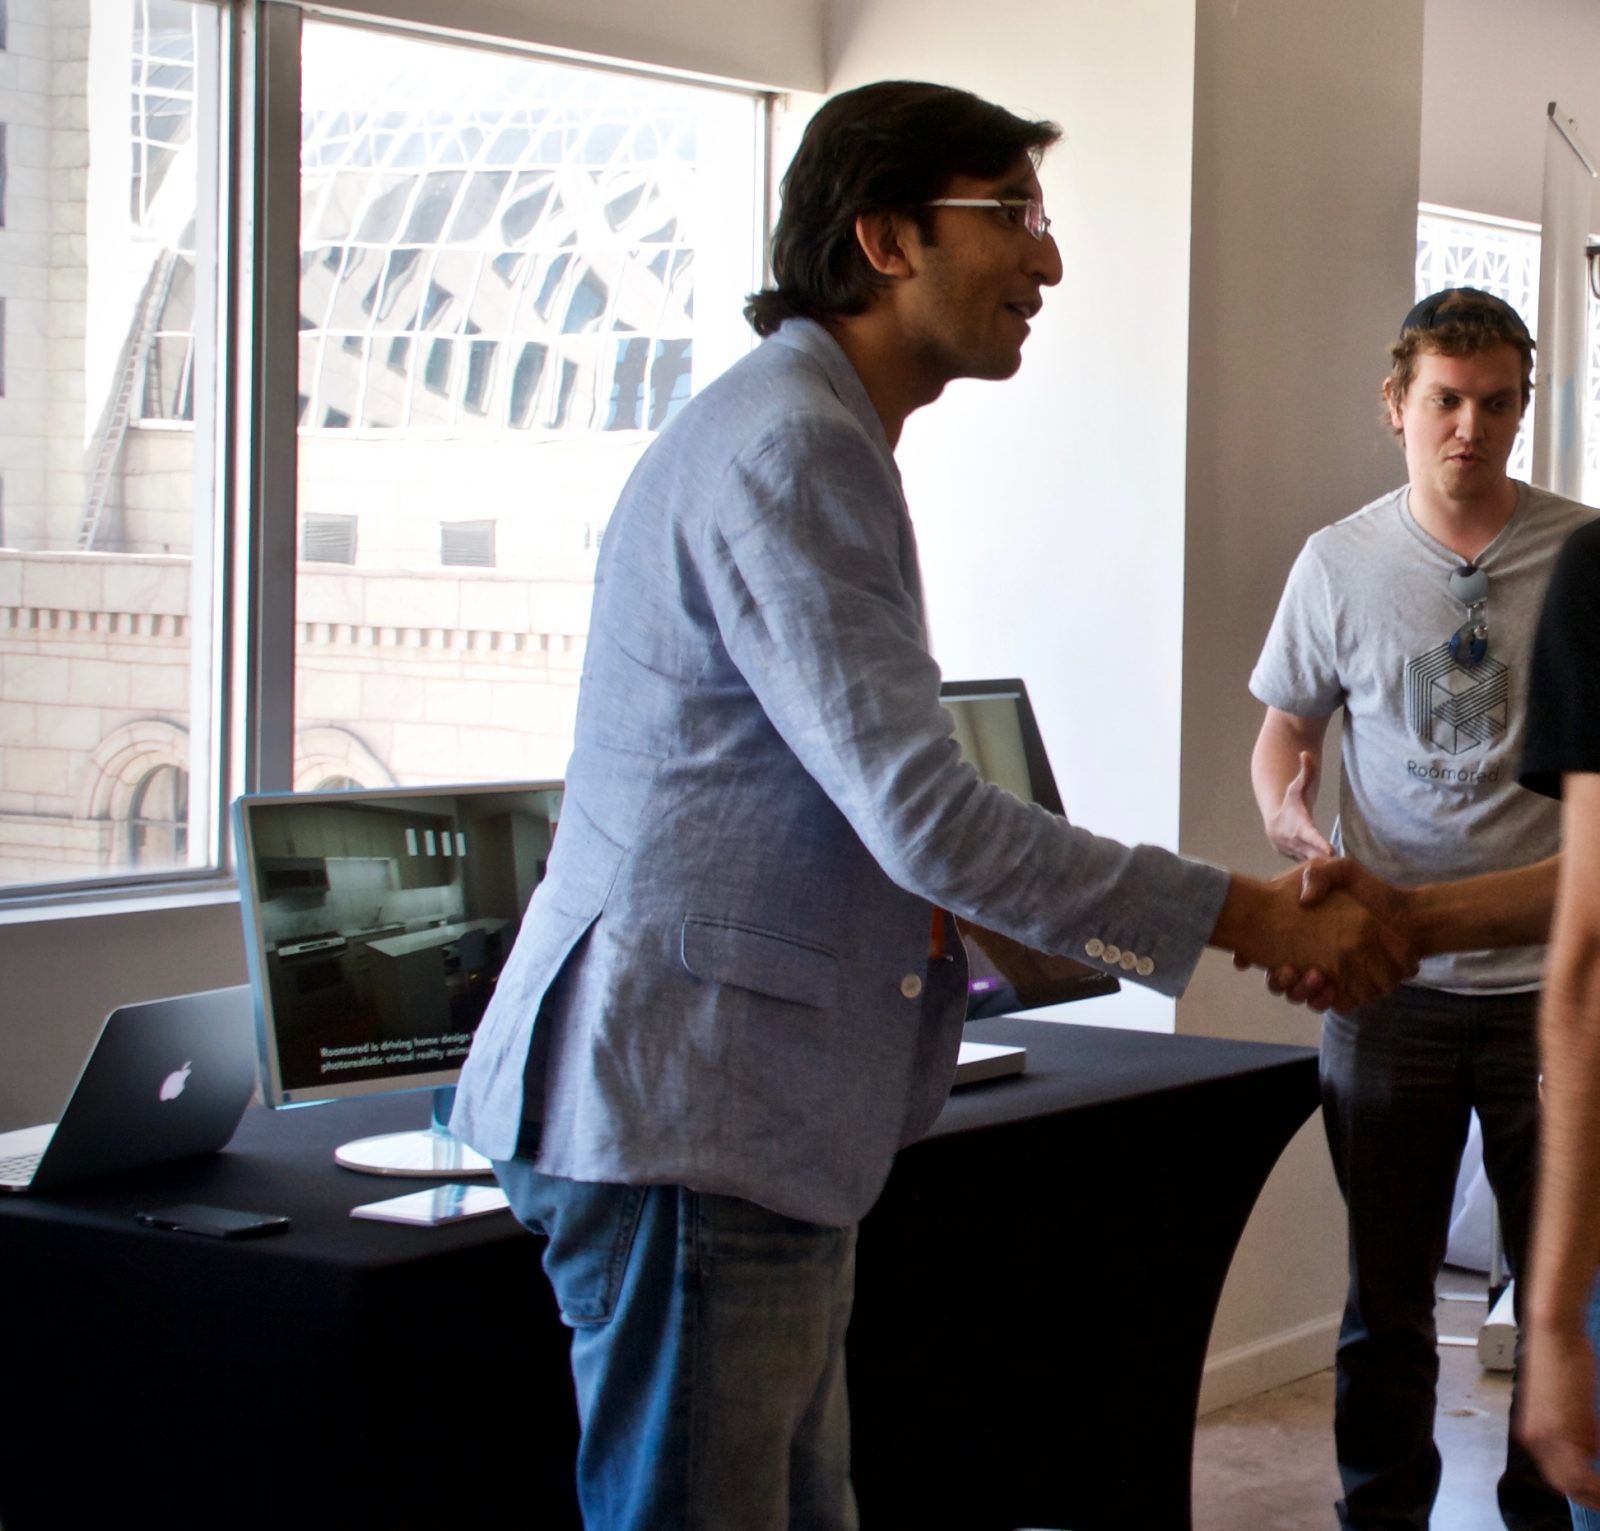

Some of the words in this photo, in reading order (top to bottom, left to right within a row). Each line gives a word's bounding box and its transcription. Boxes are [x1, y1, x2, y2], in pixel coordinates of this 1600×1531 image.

[371, 1043, 379, 1052] is
[381, 1039, 412, 1050] driving
[414, 1038, 438, 1046] home
[441, 1033, 471, 1044] design
[386, 1052, 414, 1063] virtual
[416, 1049, 444, 1060] reality
